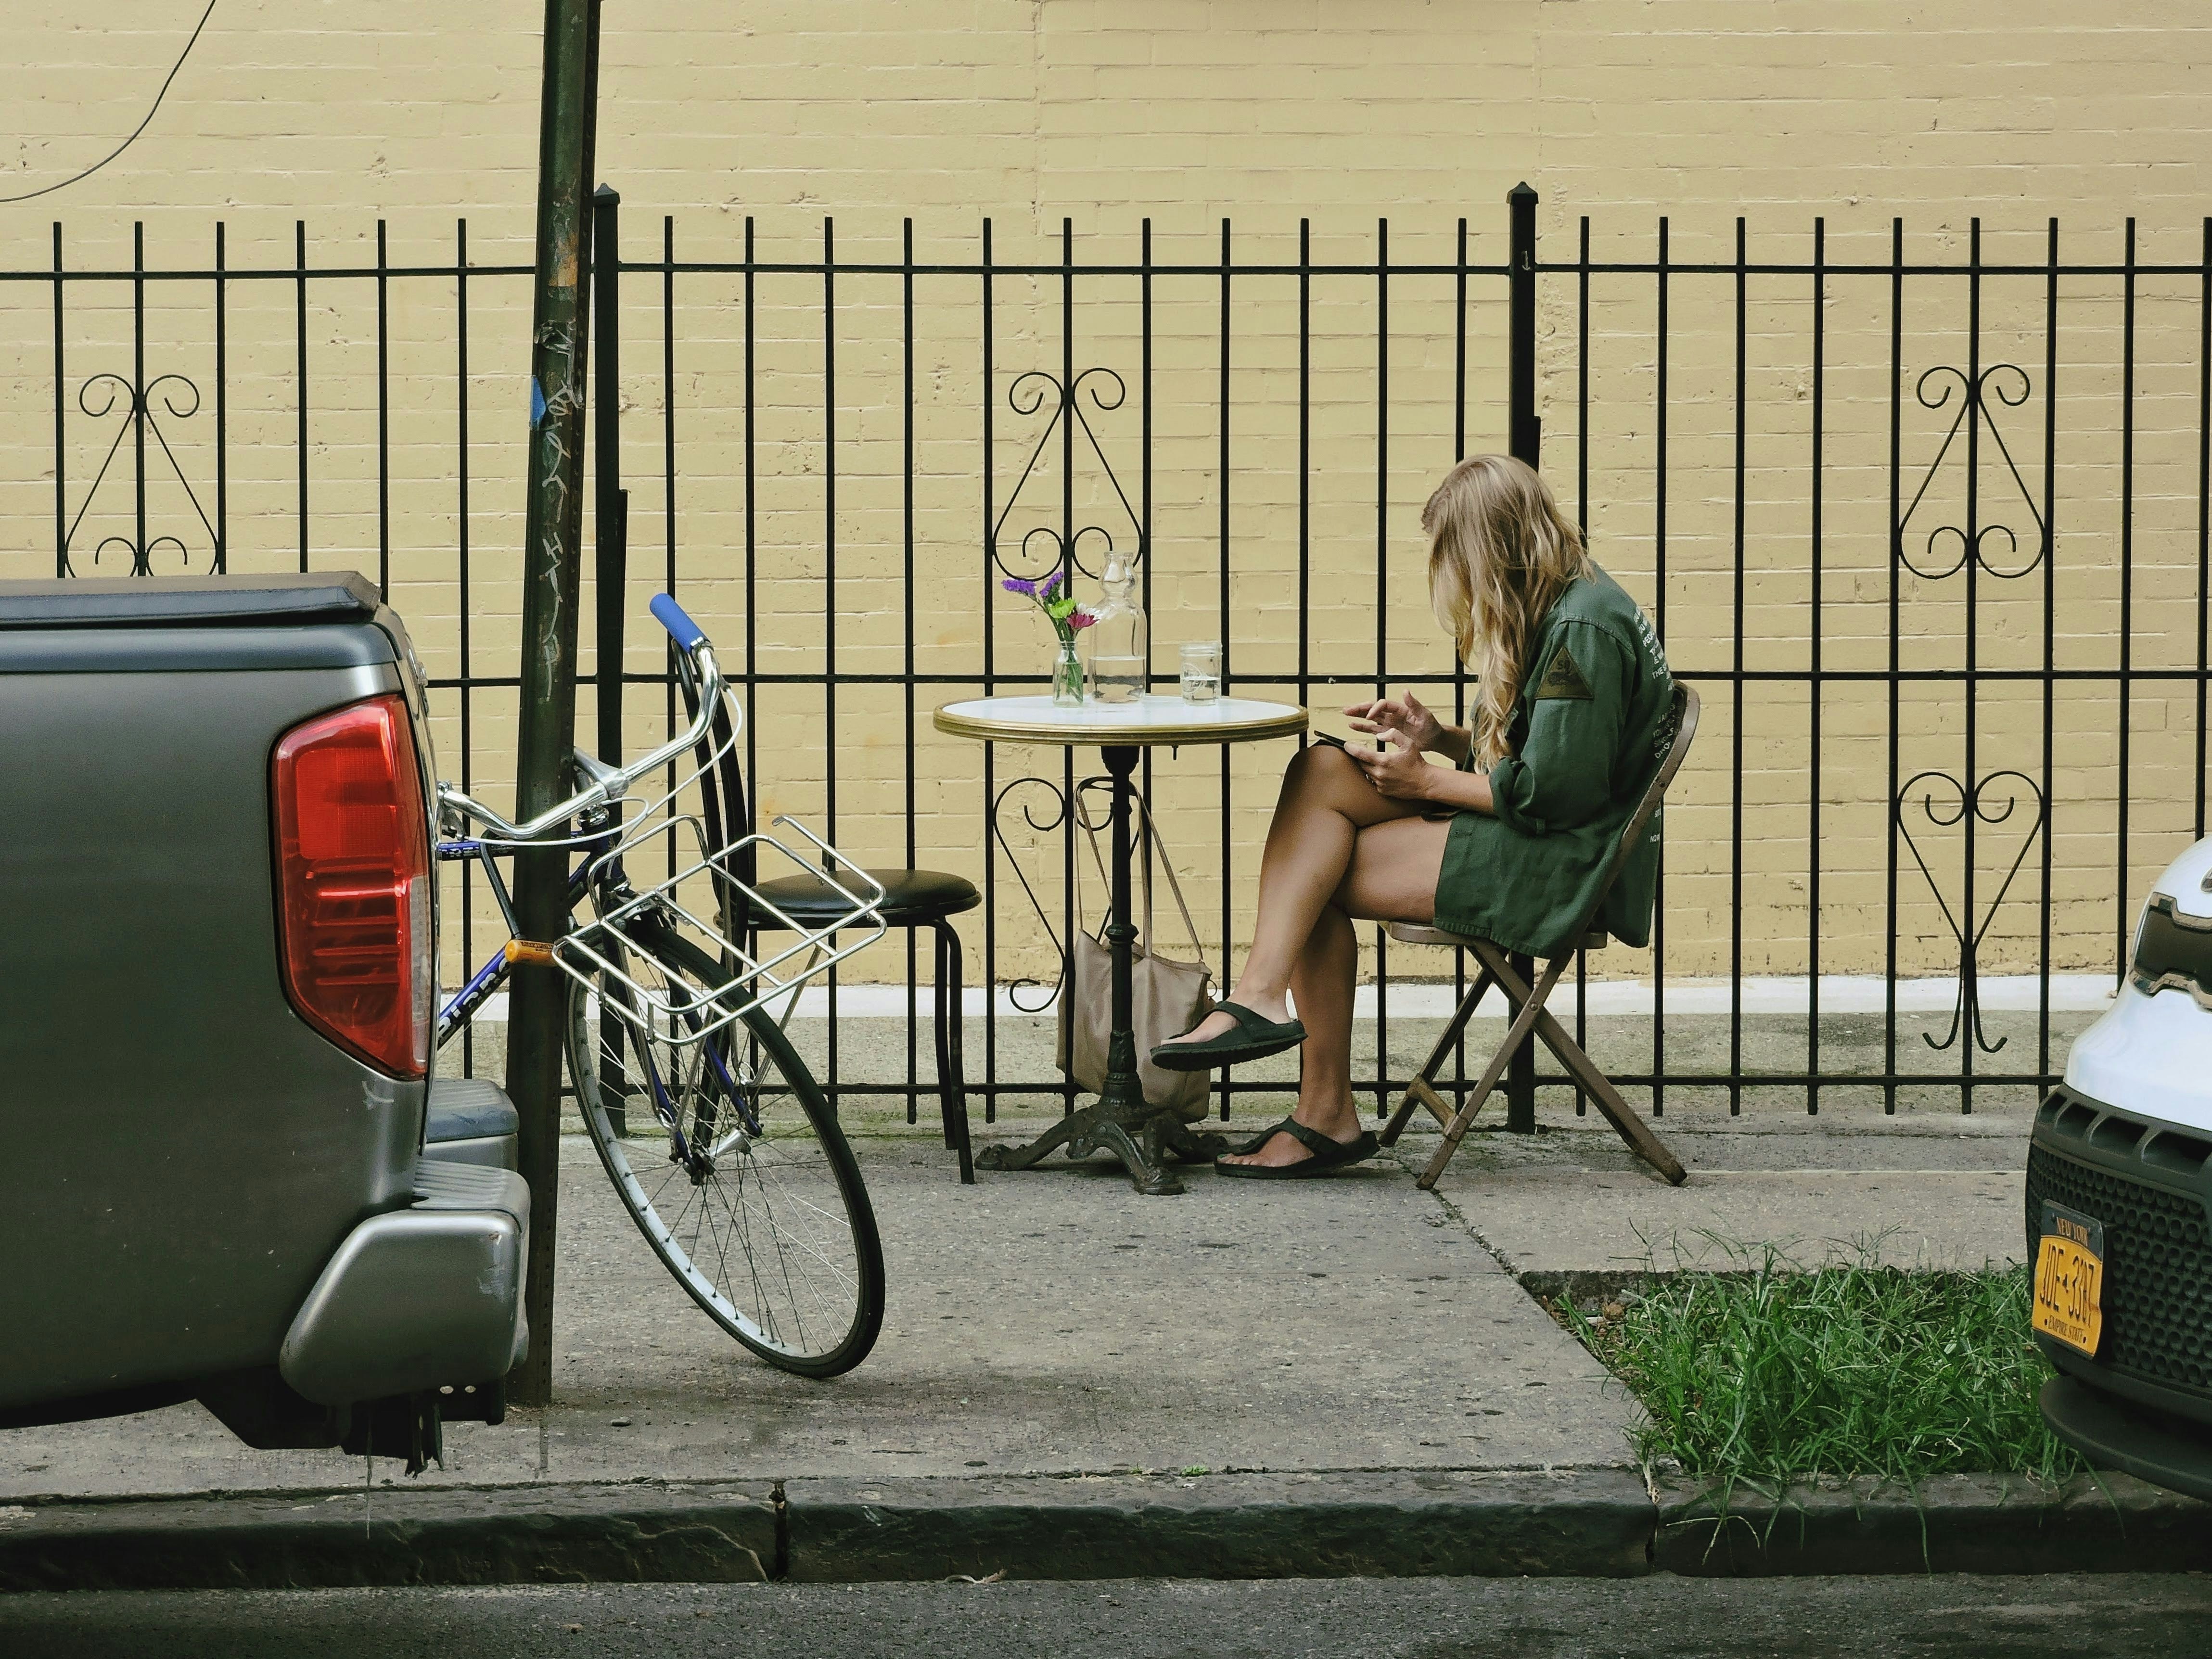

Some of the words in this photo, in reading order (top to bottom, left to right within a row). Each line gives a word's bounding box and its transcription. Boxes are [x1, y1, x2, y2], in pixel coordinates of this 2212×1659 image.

[2057, 1217, 2071, 1237] NEW
[2048, 1314, 2068, 1336] EMPIRE
[2068, 1325, 2084, 1343] STATE
